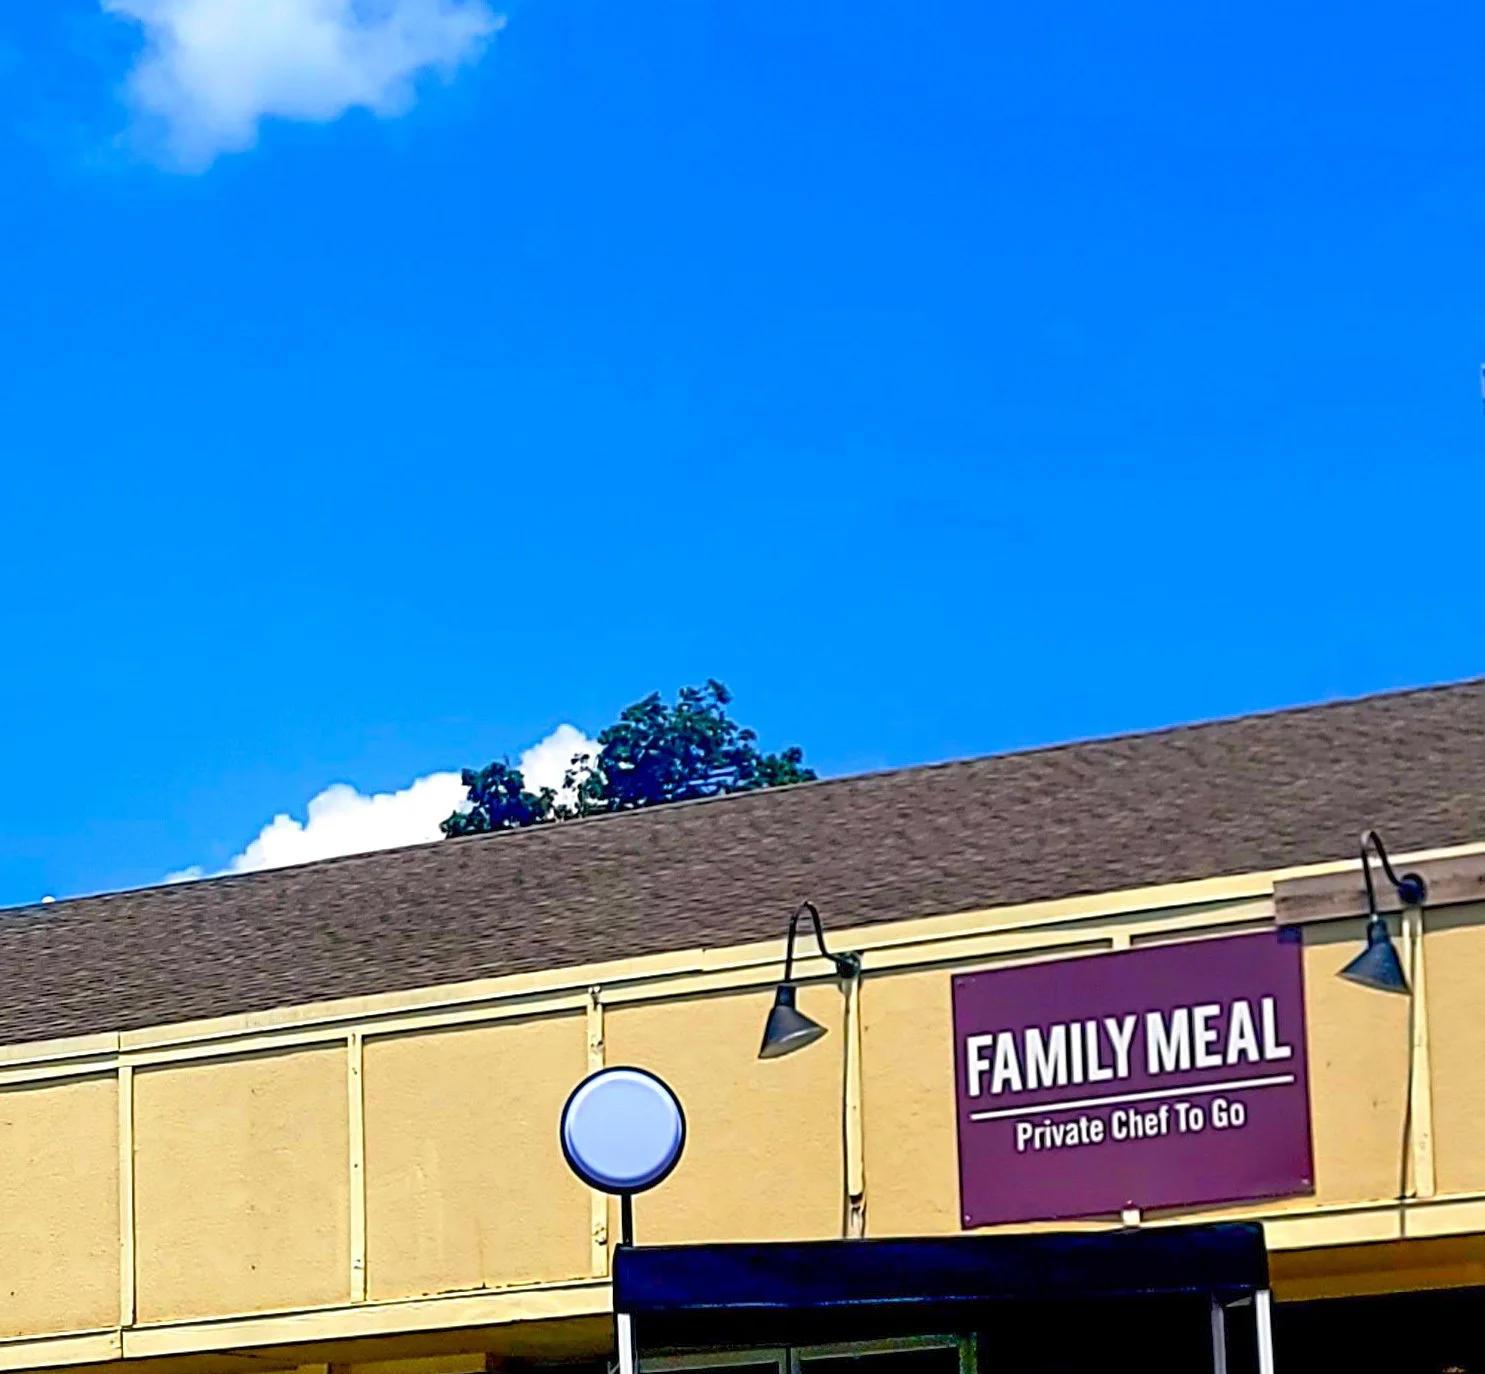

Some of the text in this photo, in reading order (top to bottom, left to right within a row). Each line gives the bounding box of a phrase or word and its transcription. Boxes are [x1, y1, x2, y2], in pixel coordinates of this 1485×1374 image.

[966, 996, 1292, 1097] FAMILY MEAL
[1015, 1097, 1245, 1152] Private Chef To Go
